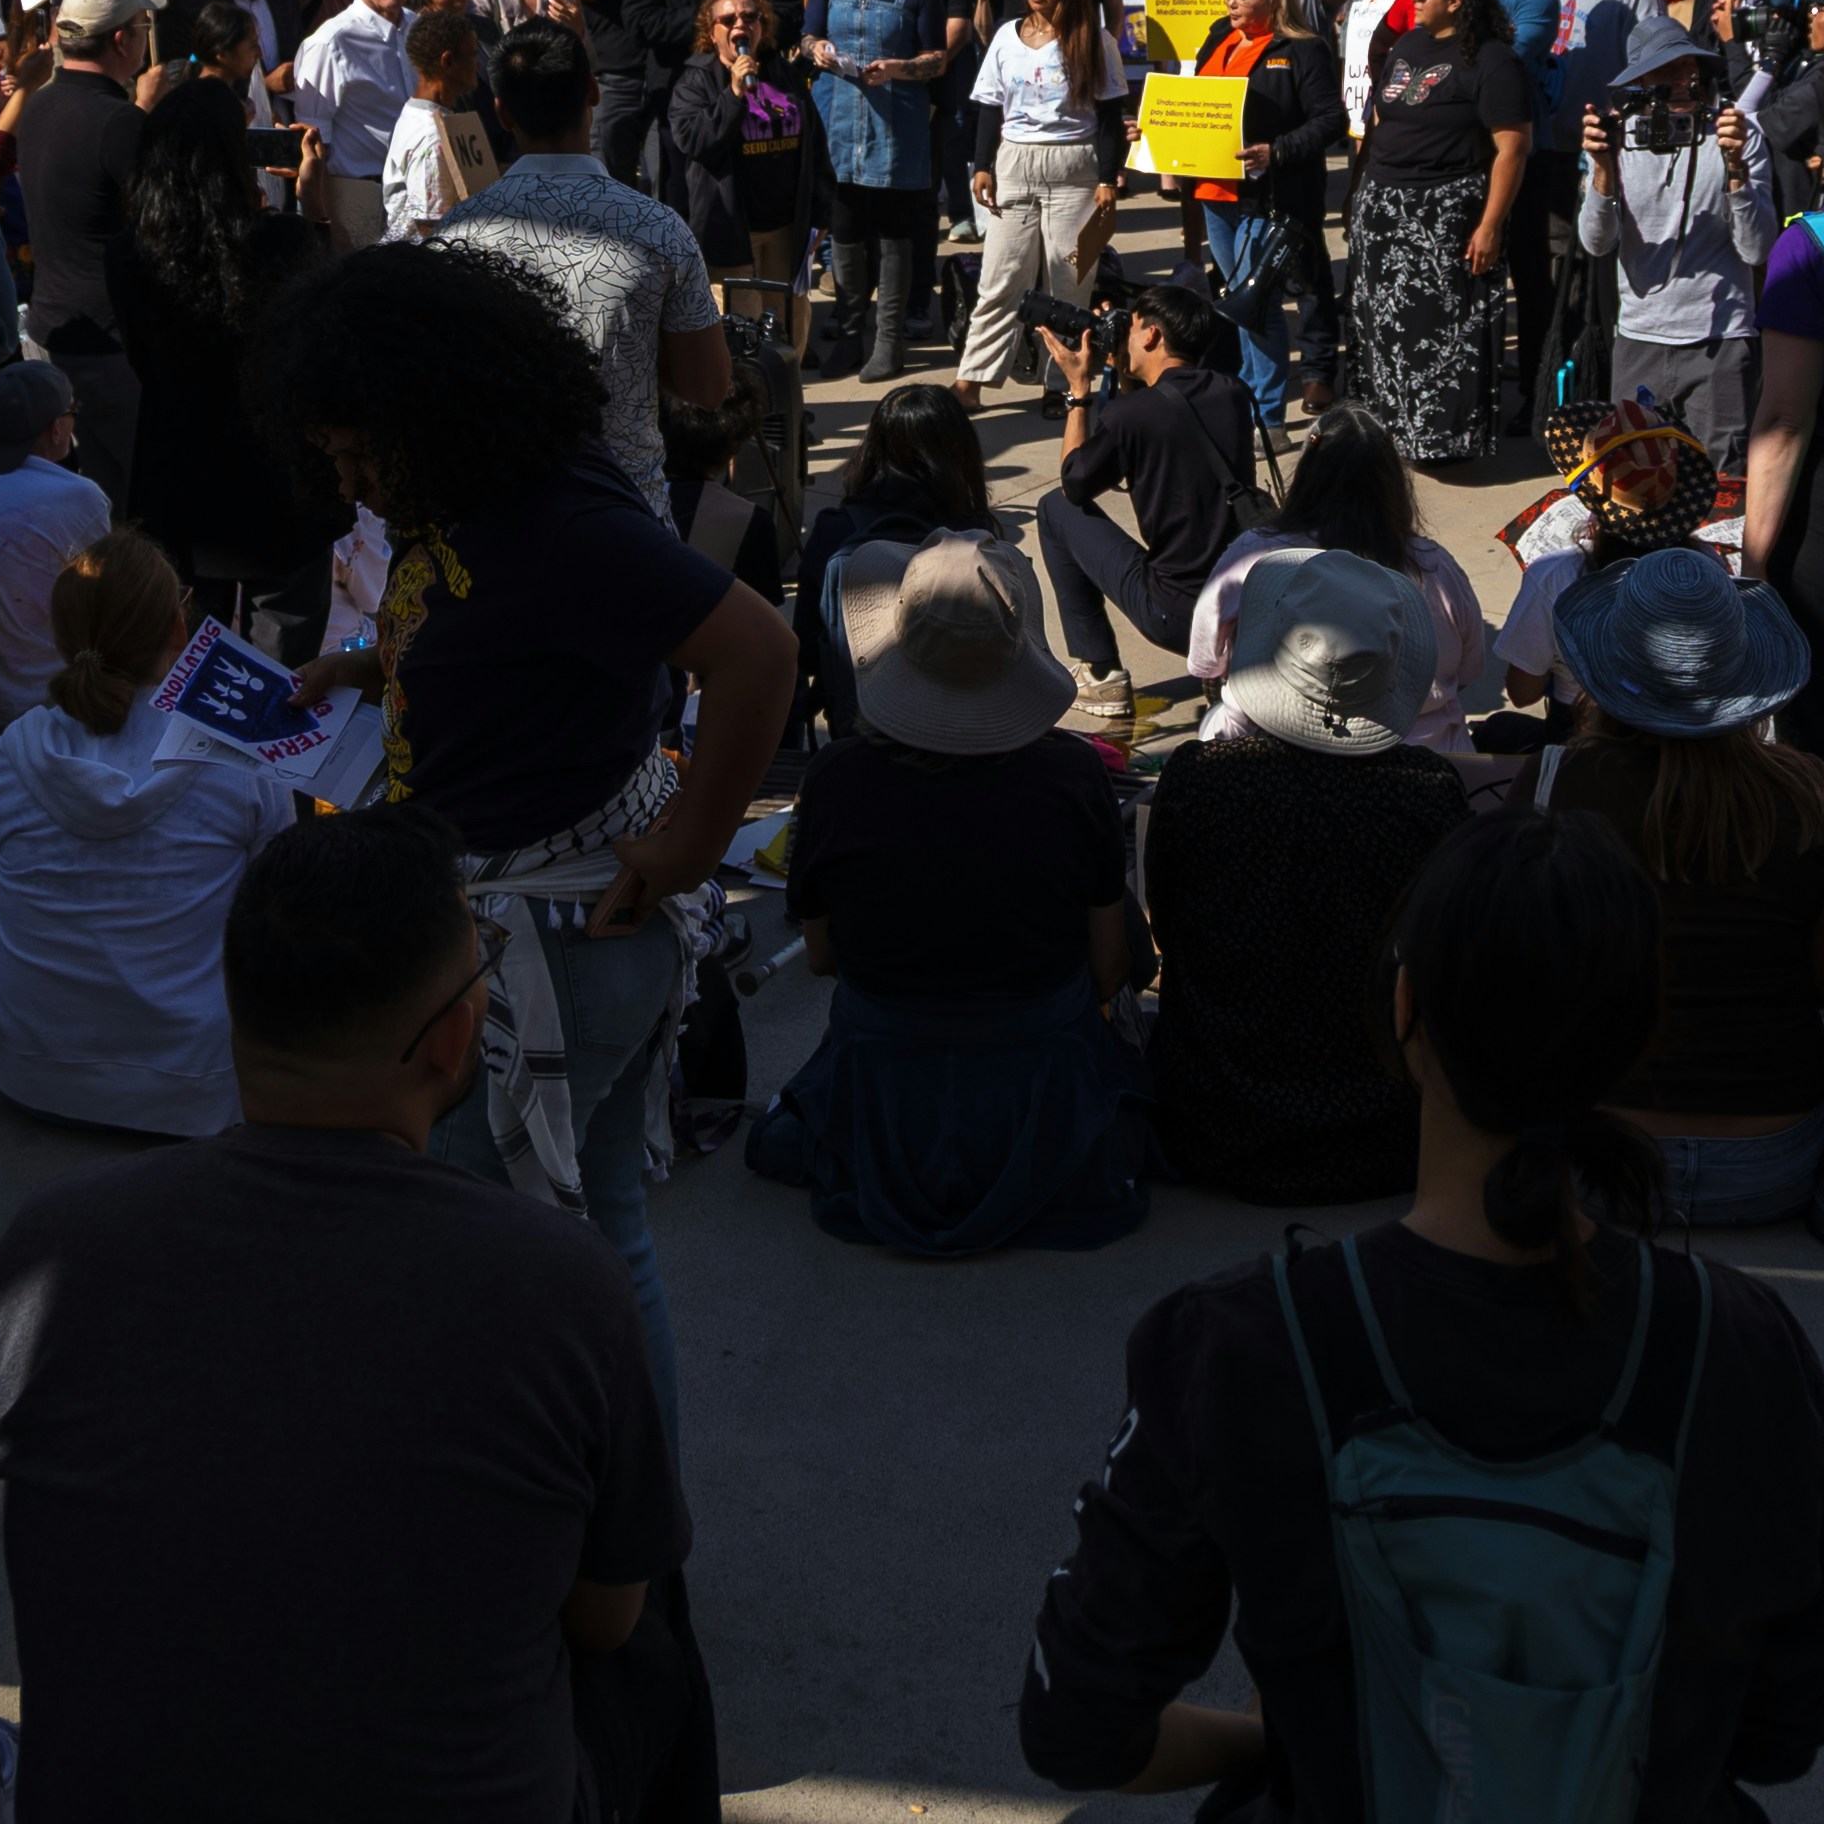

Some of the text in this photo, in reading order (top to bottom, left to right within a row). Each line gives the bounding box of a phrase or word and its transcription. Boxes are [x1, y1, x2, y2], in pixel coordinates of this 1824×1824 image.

[1155, 0, 1170, 7] pay
[1156, 98, 1233, 110] Undocumented immigrants
[1150, 109, 1164, 117] pay
[1165, 109, 1185, 117] billions
[1149, 118, 1233, 131] Medicare and Social Security
[742, 142, 767, 156] SEIU
[153, 619, 222, 712] SOLUTIONS
[256, 729, 332, 765] TERM
